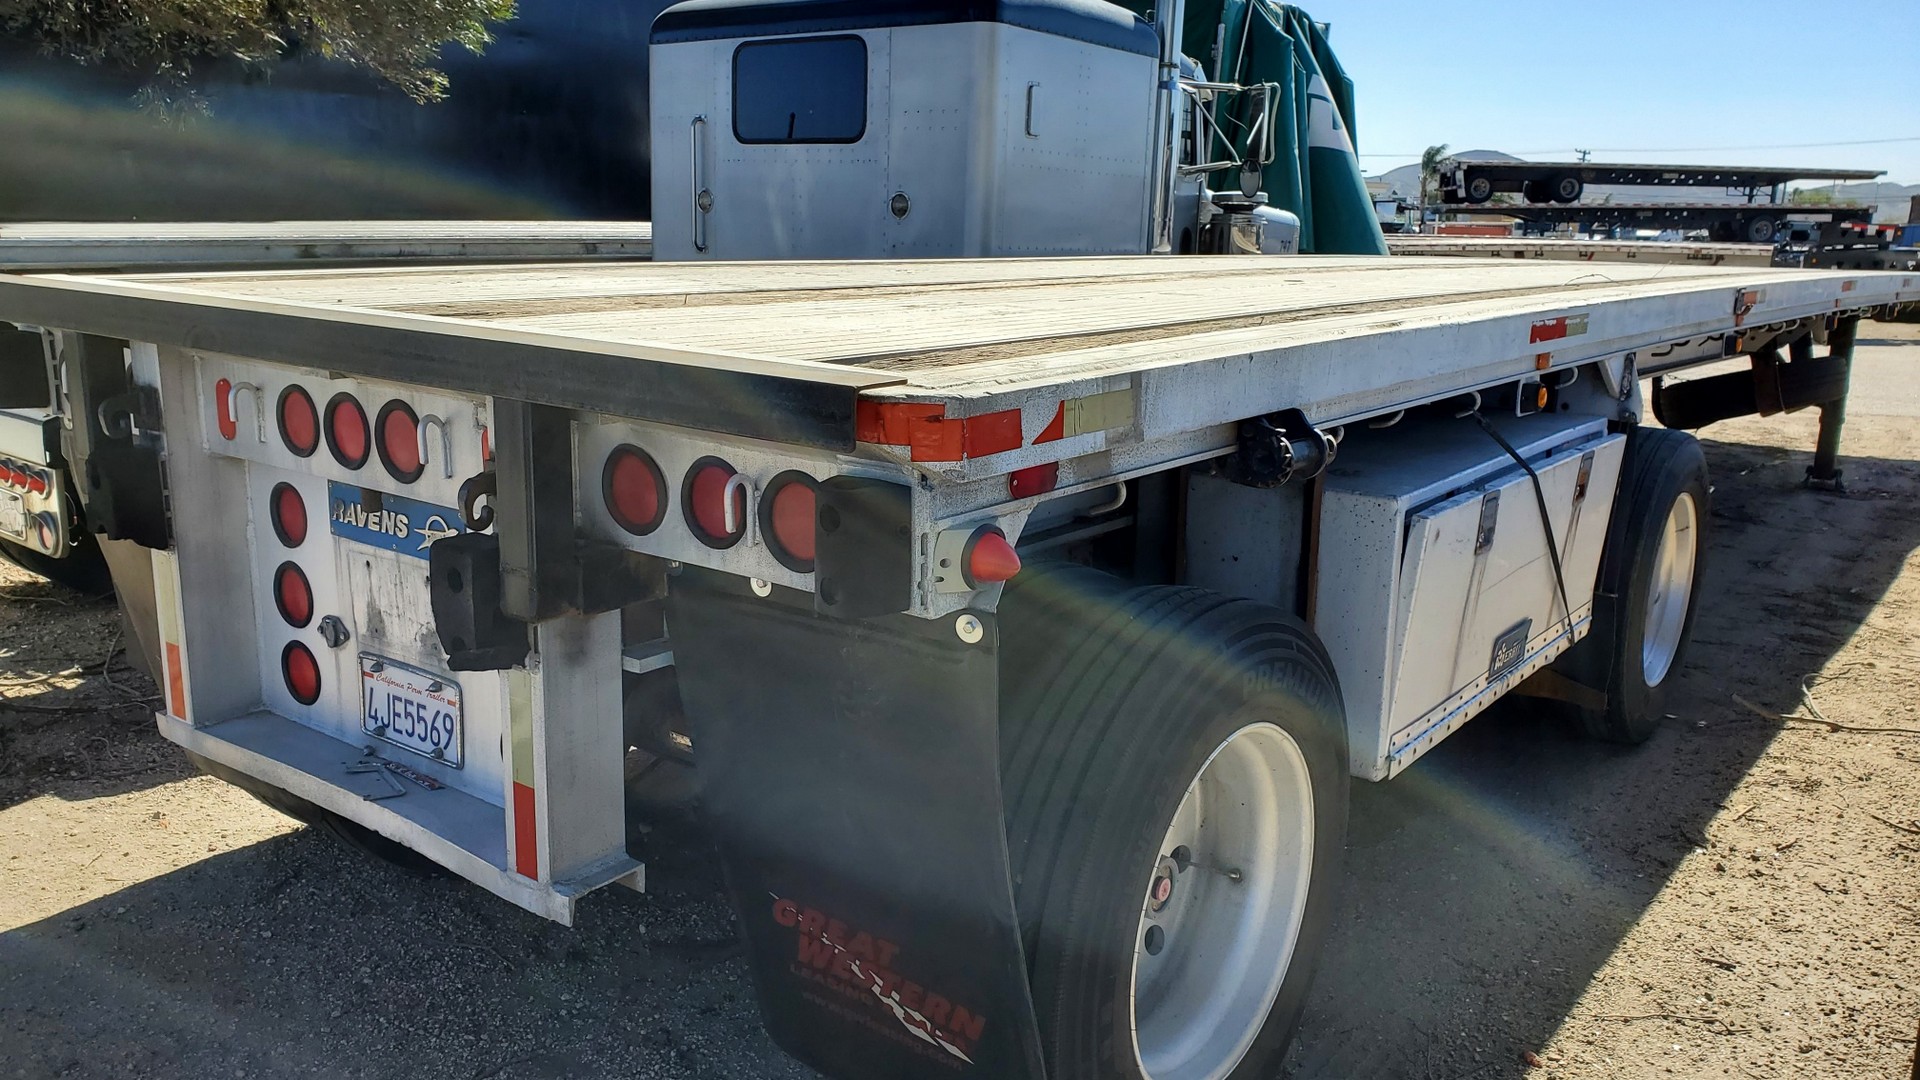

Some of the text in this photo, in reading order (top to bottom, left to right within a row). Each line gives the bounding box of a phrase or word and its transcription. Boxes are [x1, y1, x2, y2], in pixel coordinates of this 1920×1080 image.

[332, 497, 409, 538] RAVENS
[368, 687, 454, 750] 4JE5569
[375, 673, 405, 688] California
[425, 690, 446, 703] Trailer
[773, 899, 899, 967] GREAT
[797, 933, 987, 1041] WESTERN
